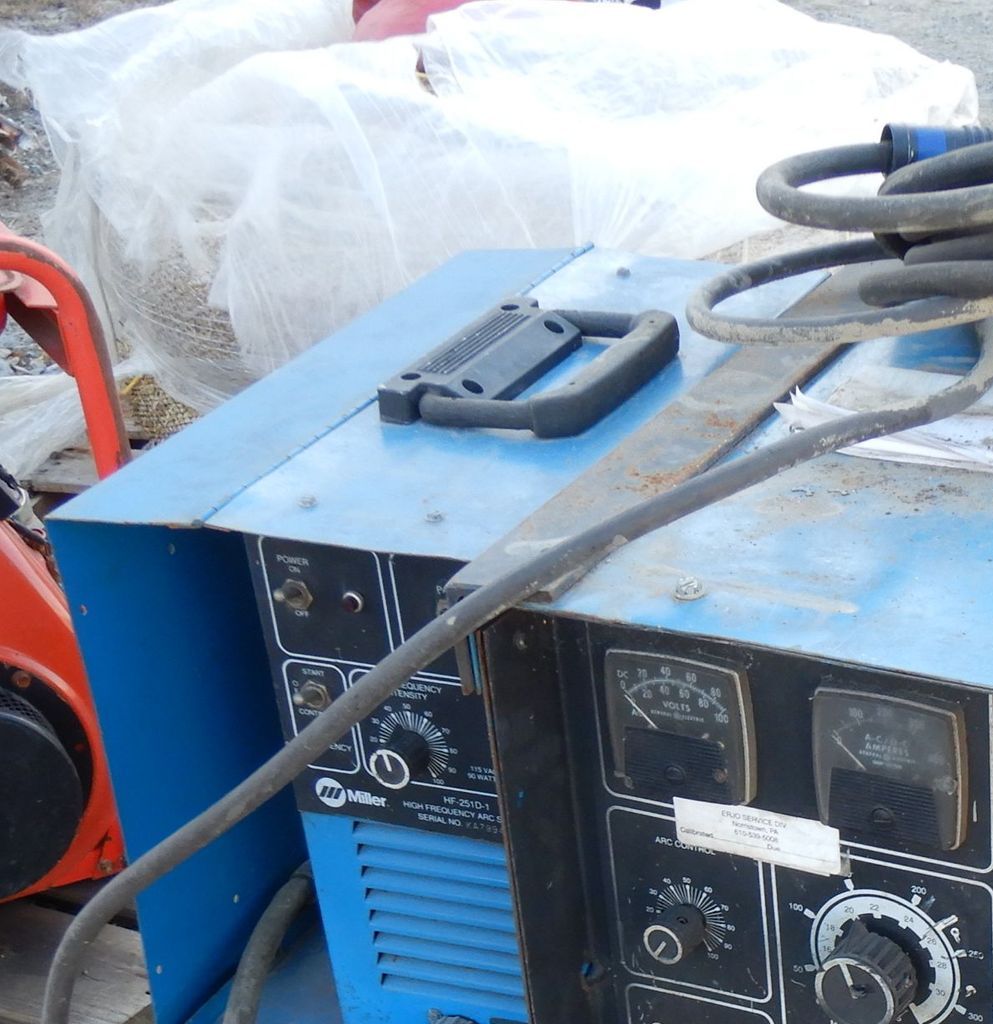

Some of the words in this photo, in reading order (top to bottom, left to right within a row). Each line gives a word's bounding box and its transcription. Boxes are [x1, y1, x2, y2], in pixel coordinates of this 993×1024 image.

[276, 554, 310, 566] POWER
[294, 610, 310, 618] OFF
[301, 668, 325, 677] START
[660, 666, 672, 676] 40
[662, 700, 691, 713] VOLTS
[348, 788, 388, 808] Miller
[443, 796, 490, 811] HF-251D-1
[402, 800, 424, 810] HIGH
[425, 804, 474, 818] FREQUENCY
[477, 813, 496, 822] ARC
[418, 812, 446, 825] SERIAL
[742, 814, 772, 826] SERVICE
[654, 836, 674, 847] ARC
[674, 840, 716, 856] CONTROL
[704, 886, 713, 894] 60
[911, 885, 927, 896] 200
[720, 904, 730, 912] 70
[788, 902, 804, 912] 100
[844, 905, 854, 914] 20
[869, 904, 880, 912] 22
[903, 915, 915, 924] 24
[726, 924, 736, 932] 80
[723, 942, 733, 950] 90
[926, 936, 938, 946] 26
[708, 952, 719, 960] 100
[936, 961, 948, 970] 28
[935, 988, 946, 998] 30
[968, 1012, 984, 1022] 300
